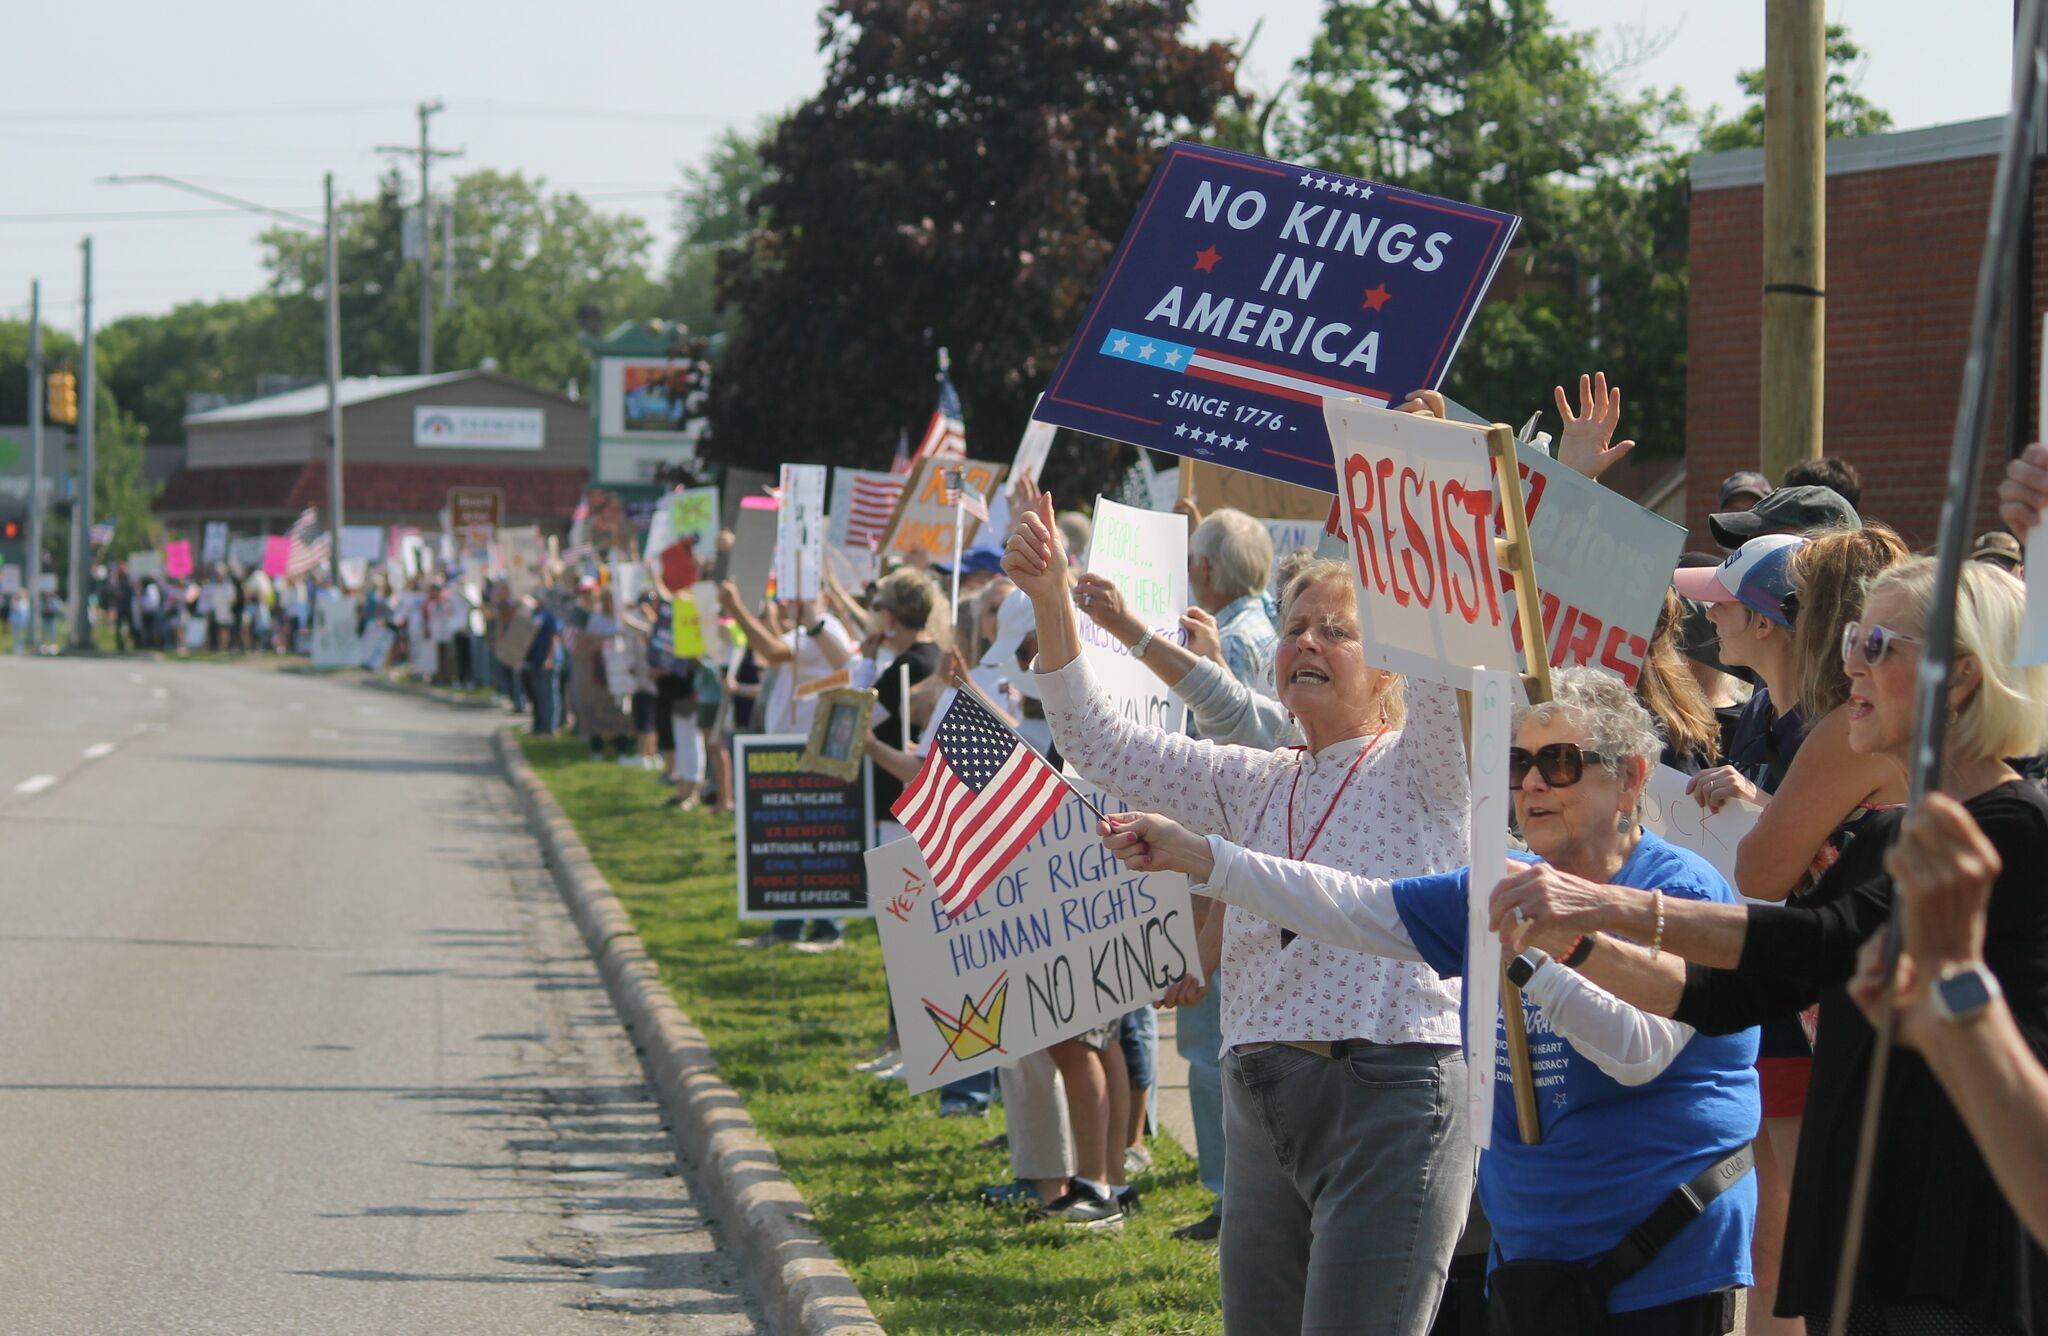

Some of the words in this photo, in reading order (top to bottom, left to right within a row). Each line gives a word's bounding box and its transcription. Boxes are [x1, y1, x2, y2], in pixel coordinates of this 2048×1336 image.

[1184, 180, 1267, 231] NO
[1279, 200, 1452, 273] KINGS
[1260, 252, 1325, 301] IN
[1144, 285, 1380, 375] AMERICA
[1166, 389, 1230, 418] SINCE
[1234, 405, 1284, 432] 1776
[1344, 453, 1501, 627] RESIST
[750, 777, 794, 788] SOCIAL
[762, 792, 844, 805] HEALTHCARE
[752, 810, 800, 822] POSTAL
[805, 809, 857, 821] SERVICE
[785, 825, 846, 837] BENEFITS
[751, 842, 816, 854] NATIONAL
[818, 840, 860, 853] PARKS
[765, 859, 797, 870] CIVIL
[801, 858, 849, 869] RIGHTS
[752, 875, 798, 887] PUBLIC
[803, 874, 861, 885] SCHOOLS
[764, 891, 797, 903] FREE
[800, 890, 850, 902] SPEECH
[885, 867, 926, 922] YES!
[996, 867, 1029, 908] OF
[949, 908, 1051, 977] HUMAN
[1060, 874, 1157, 941] RIGHTS
[1025, 955, 1075, 1037] NO
[1088, 910, 1188, 1013] KINGS
